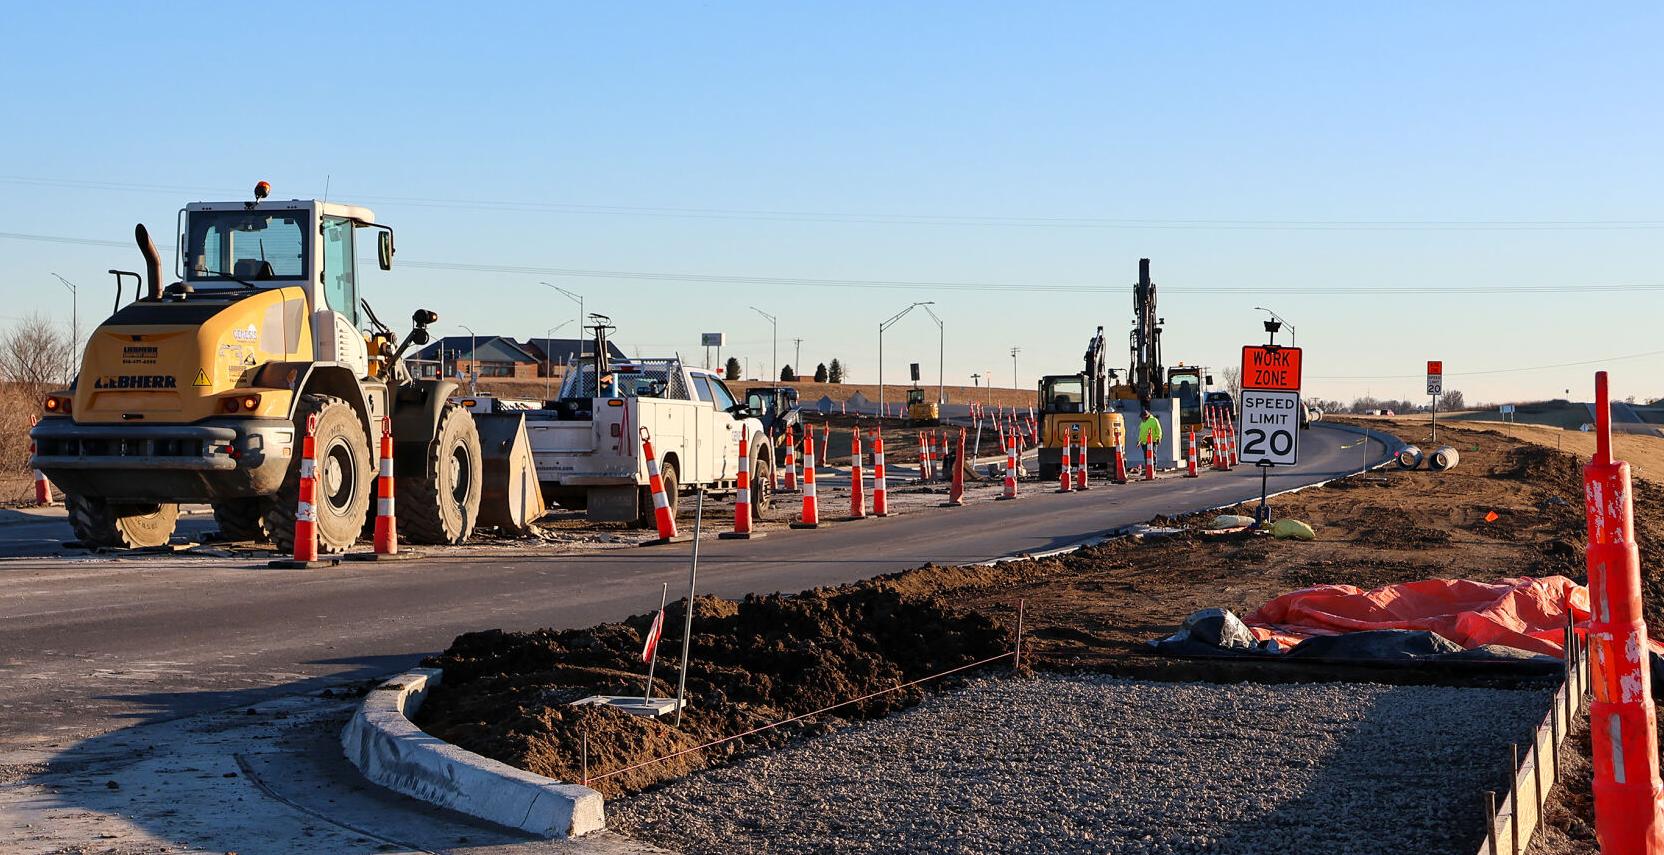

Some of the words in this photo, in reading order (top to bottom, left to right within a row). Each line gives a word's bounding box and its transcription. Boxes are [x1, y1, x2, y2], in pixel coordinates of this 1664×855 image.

[1253, 351, 1290, 367] WORK
[1254, 370, 1288, 386] ZONE
[1428, 384, 1441, 393] 20
[1245, 397, 1294, 410] SPEED
[1250, 413, 1289, 425] LIMIT
[1243, 428, 1293, 456] 20
